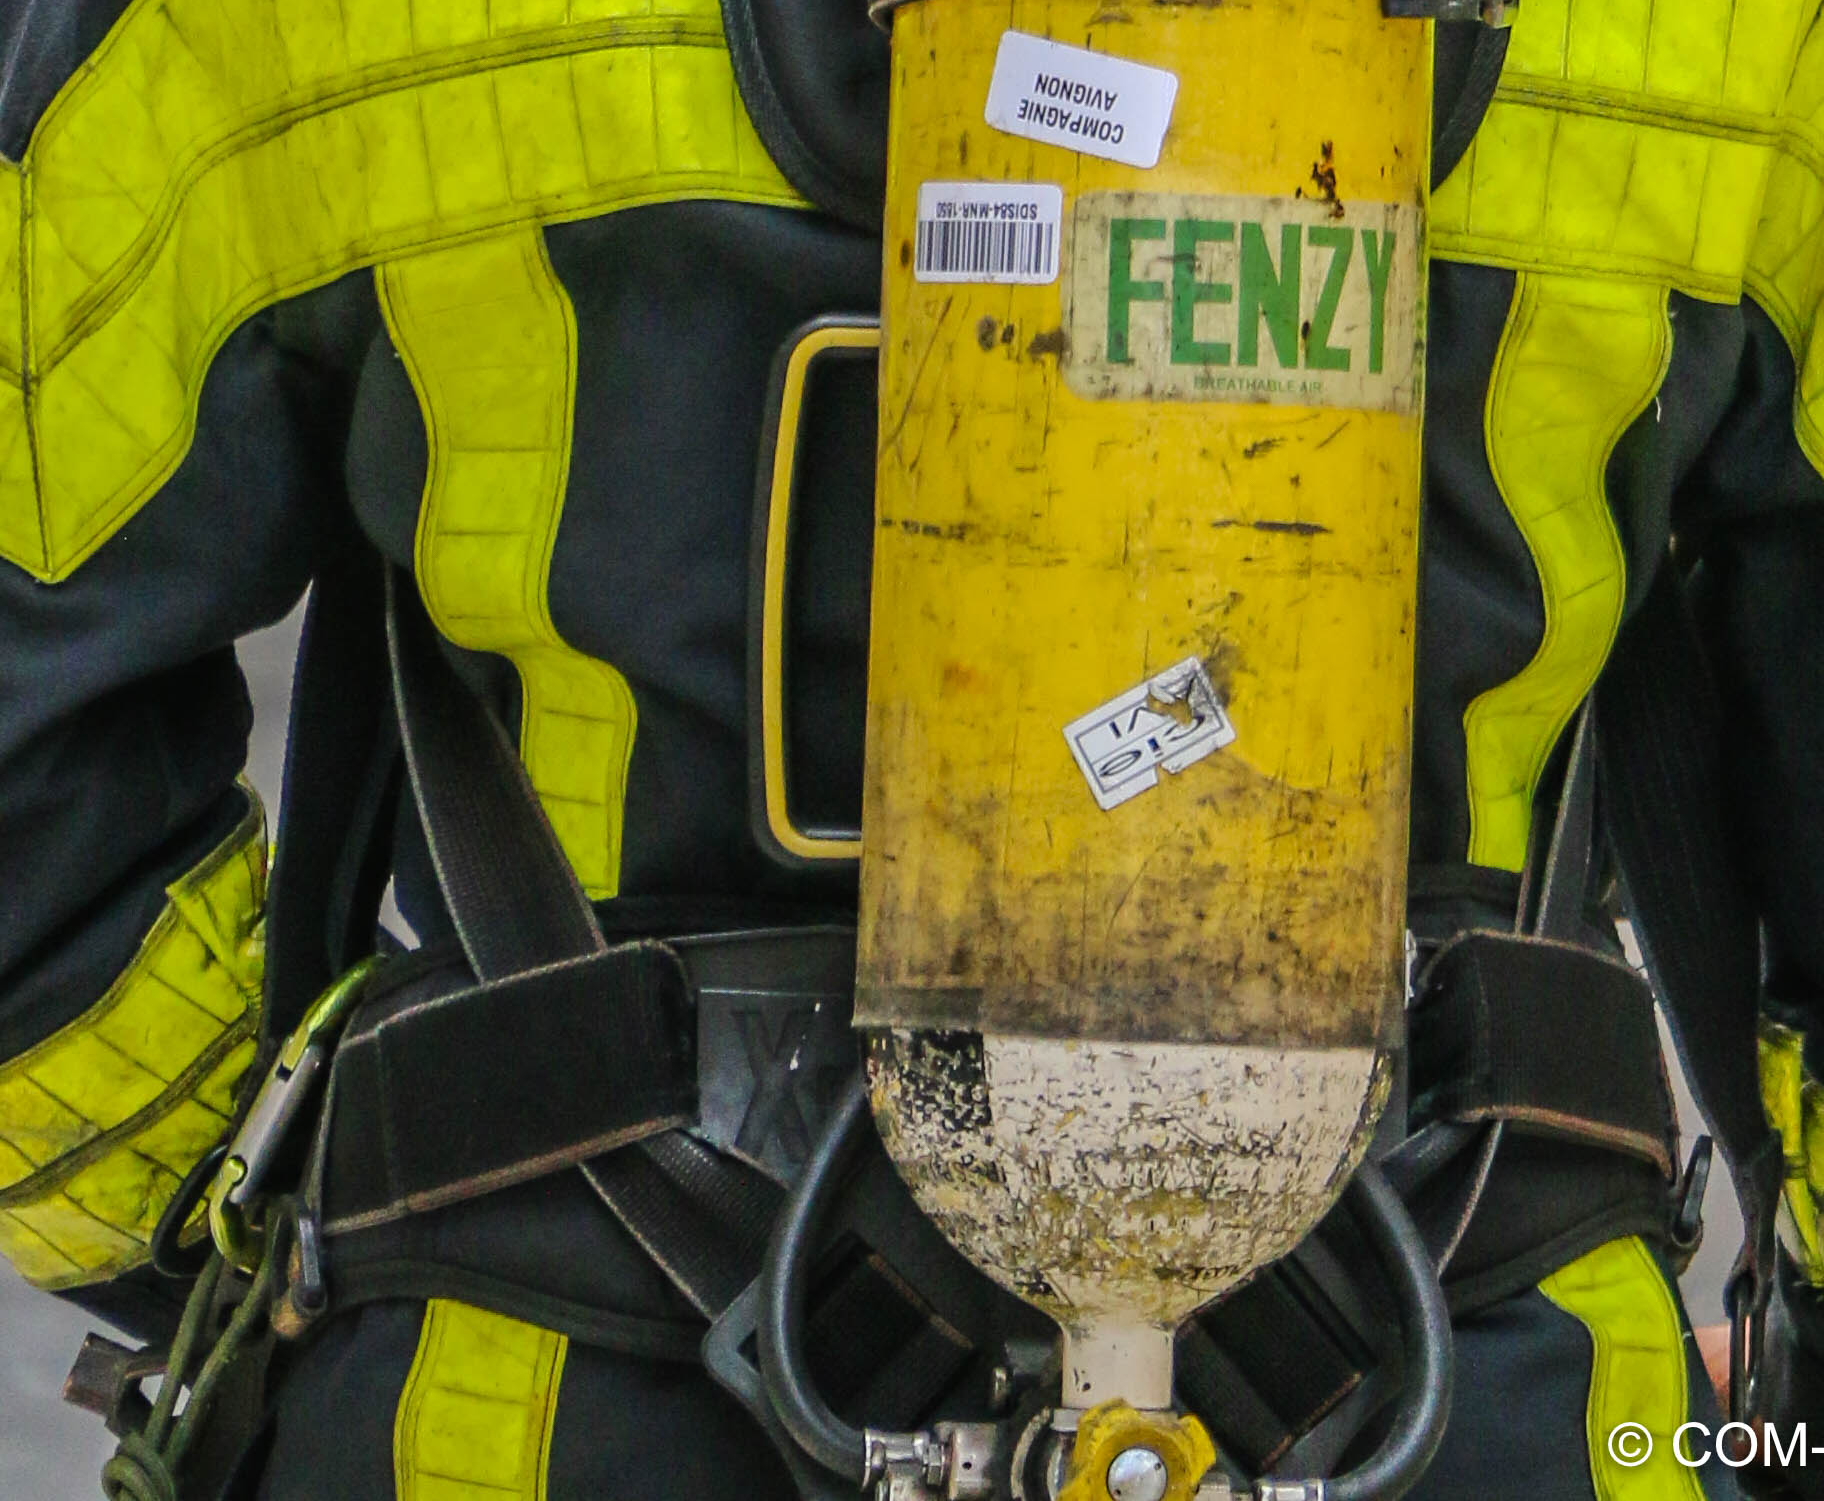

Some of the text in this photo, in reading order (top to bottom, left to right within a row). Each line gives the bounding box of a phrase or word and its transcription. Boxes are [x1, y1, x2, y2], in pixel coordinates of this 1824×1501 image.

[1034, 73, 1118, 112] AVIGNON
[1017, 98, 1124, 144] COMPAGNIE
[1106, 218, 1397, 375] FENZY
[1193, 376, 1322, 393] BREATHABLE AIR
